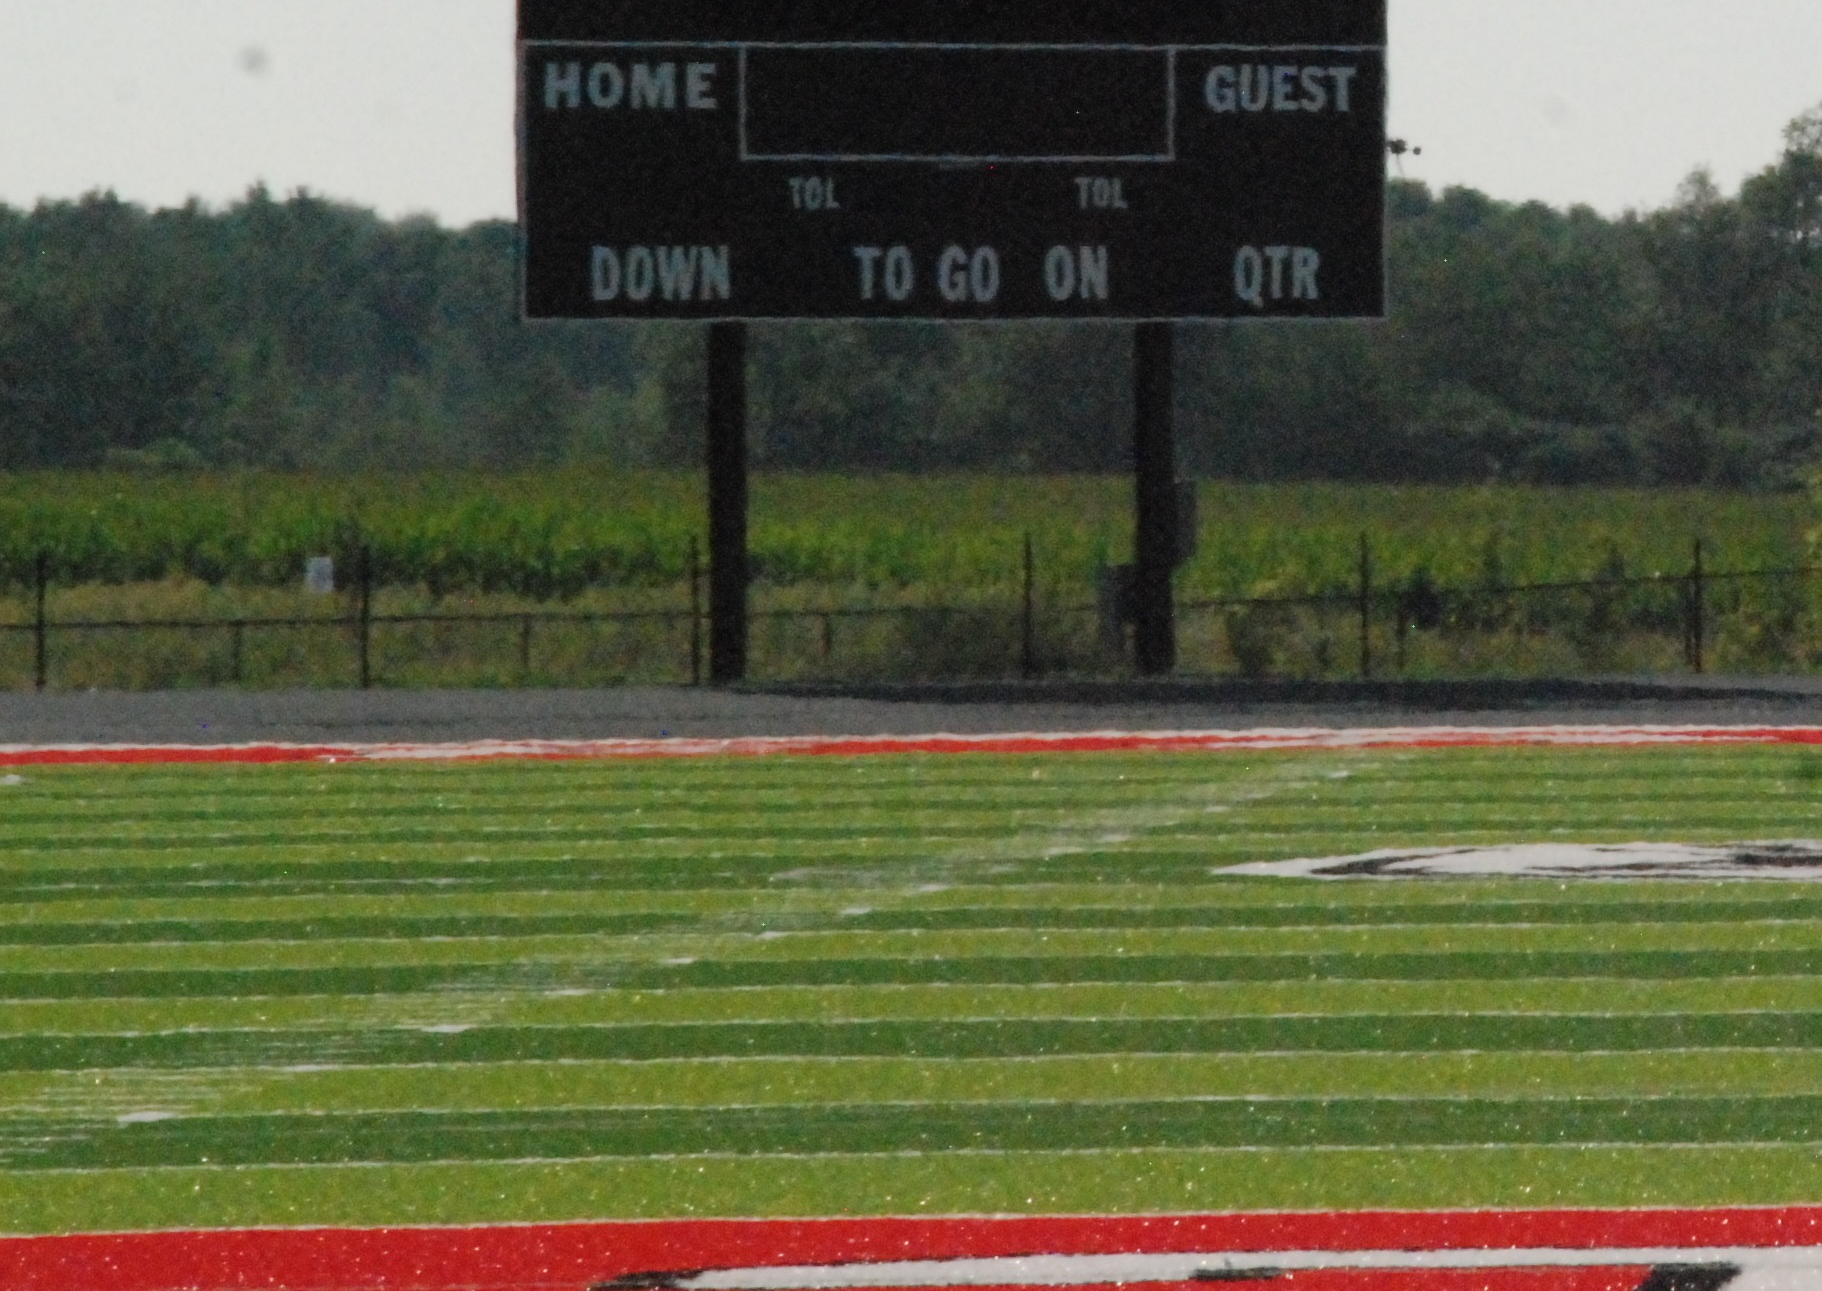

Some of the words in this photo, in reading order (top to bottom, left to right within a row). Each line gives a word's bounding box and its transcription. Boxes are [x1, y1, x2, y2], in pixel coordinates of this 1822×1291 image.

[543, 60, 718, 109] HOME
[1205, 64, 1356, 113] GUEST
[789, 175, 841, 211] TOL
[1074, 175, 1128, 209] TOL
[591, 245, 731, 301] DOWN
[853, 245, 914, 301] TO
[938, 245, 1000, 303] GO
[1044, 245, 1109, 300] ON
[1233, 245, 1321, 308] QTR
